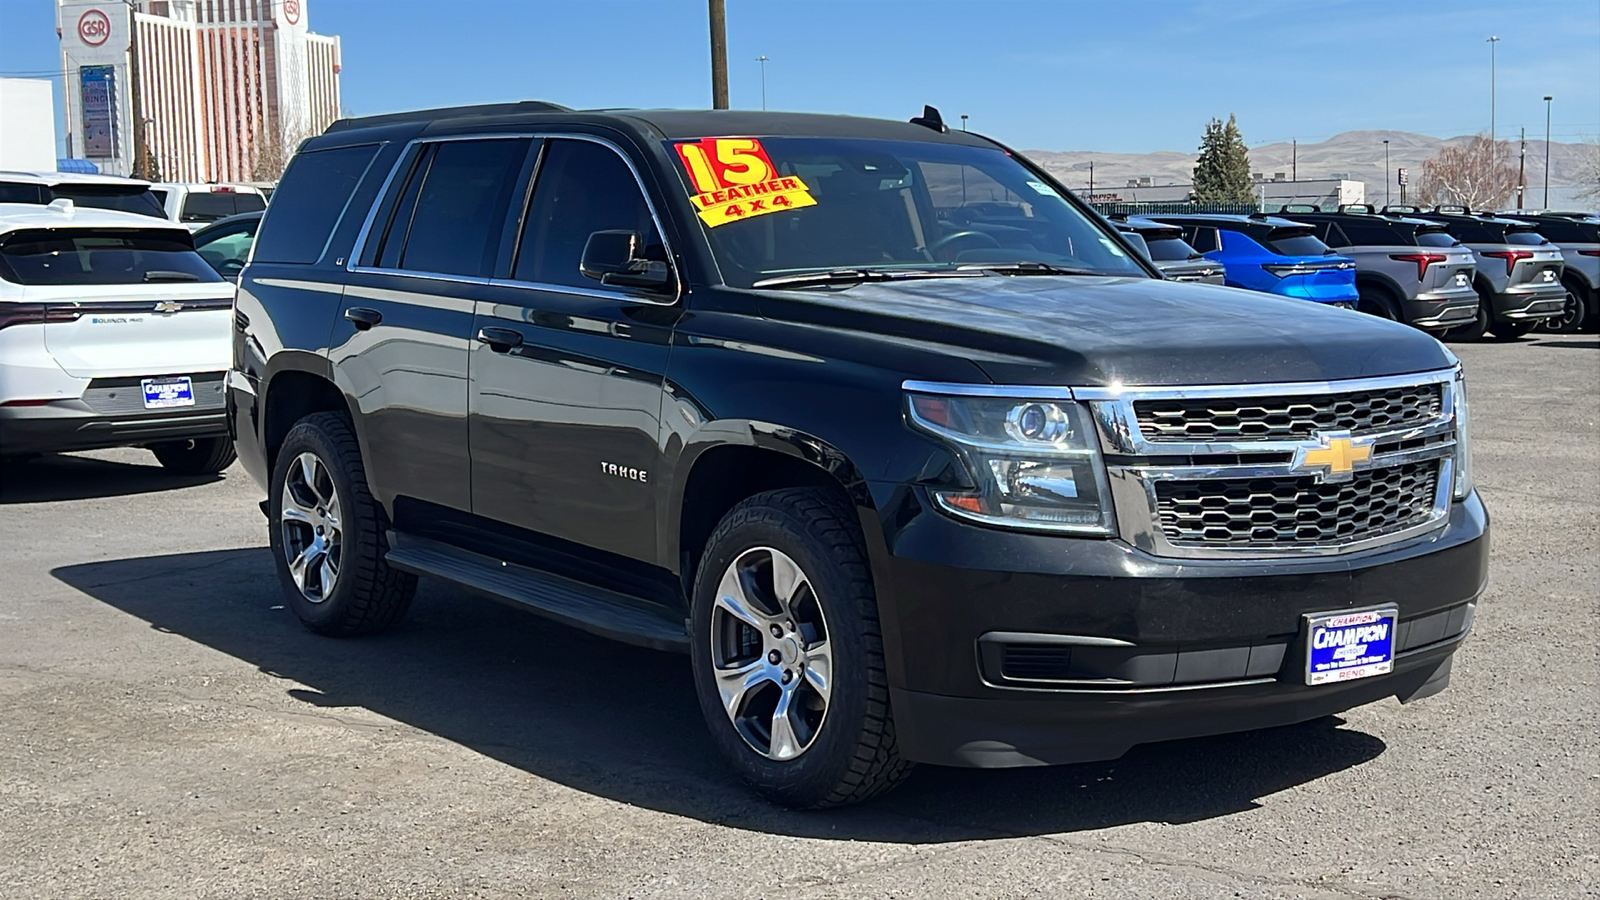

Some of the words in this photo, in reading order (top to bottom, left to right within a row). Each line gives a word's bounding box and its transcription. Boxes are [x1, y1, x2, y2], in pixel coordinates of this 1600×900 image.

[82, 20, 106, 37] GSR
[682, 139, 772, 192] 15
[700, 178, 799, 207] LEATHER
[601, 461, 647, 483] TAHOE
[1333, 615, 1373, 626] CHAMPION
[1314, 624, 1388, 649] CHAMPION
[1339, 669, 1365, 678] RENO
